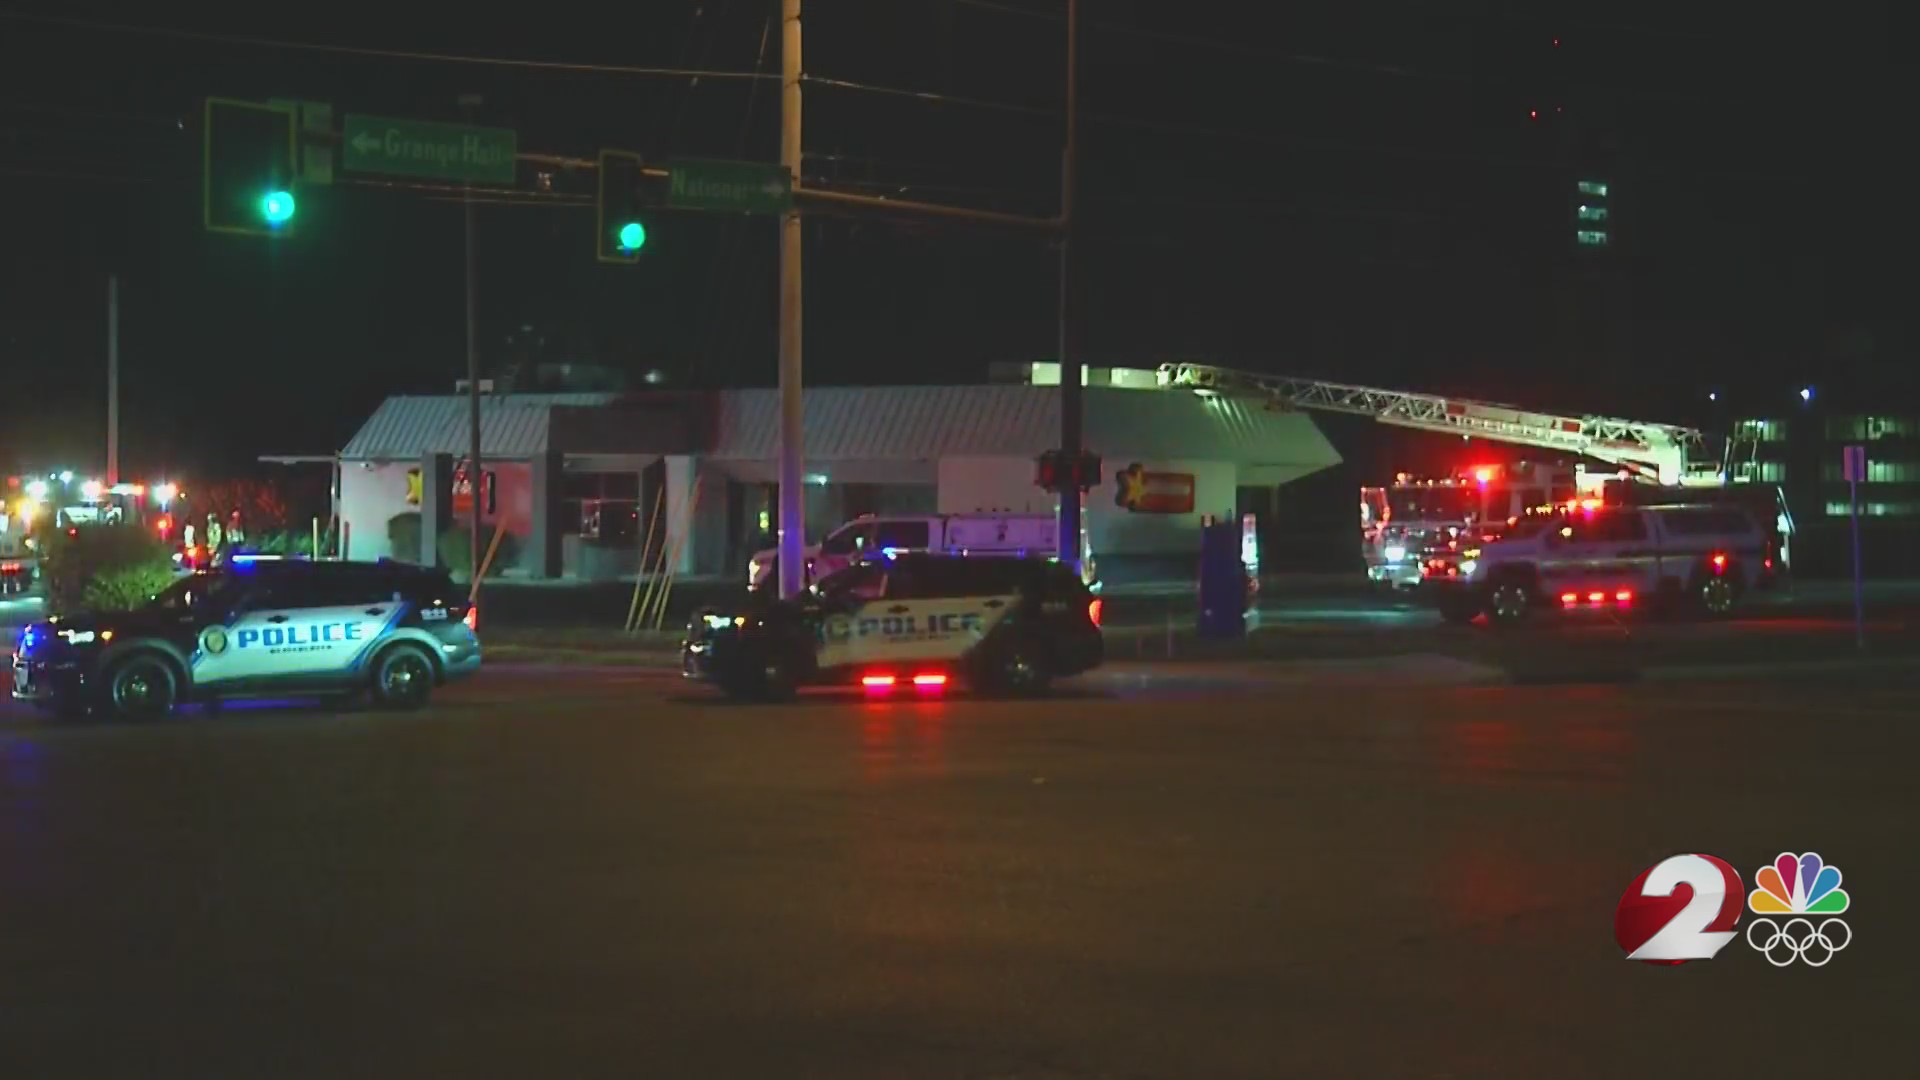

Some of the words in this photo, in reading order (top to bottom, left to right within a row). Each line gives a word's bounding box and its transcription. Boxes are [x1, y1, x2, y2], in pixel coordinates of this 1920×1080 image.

[384, 127, 459, 168] Grange
[237, 621, 363, 648] POLICE
[858, 612, 982, 637] POLICE
